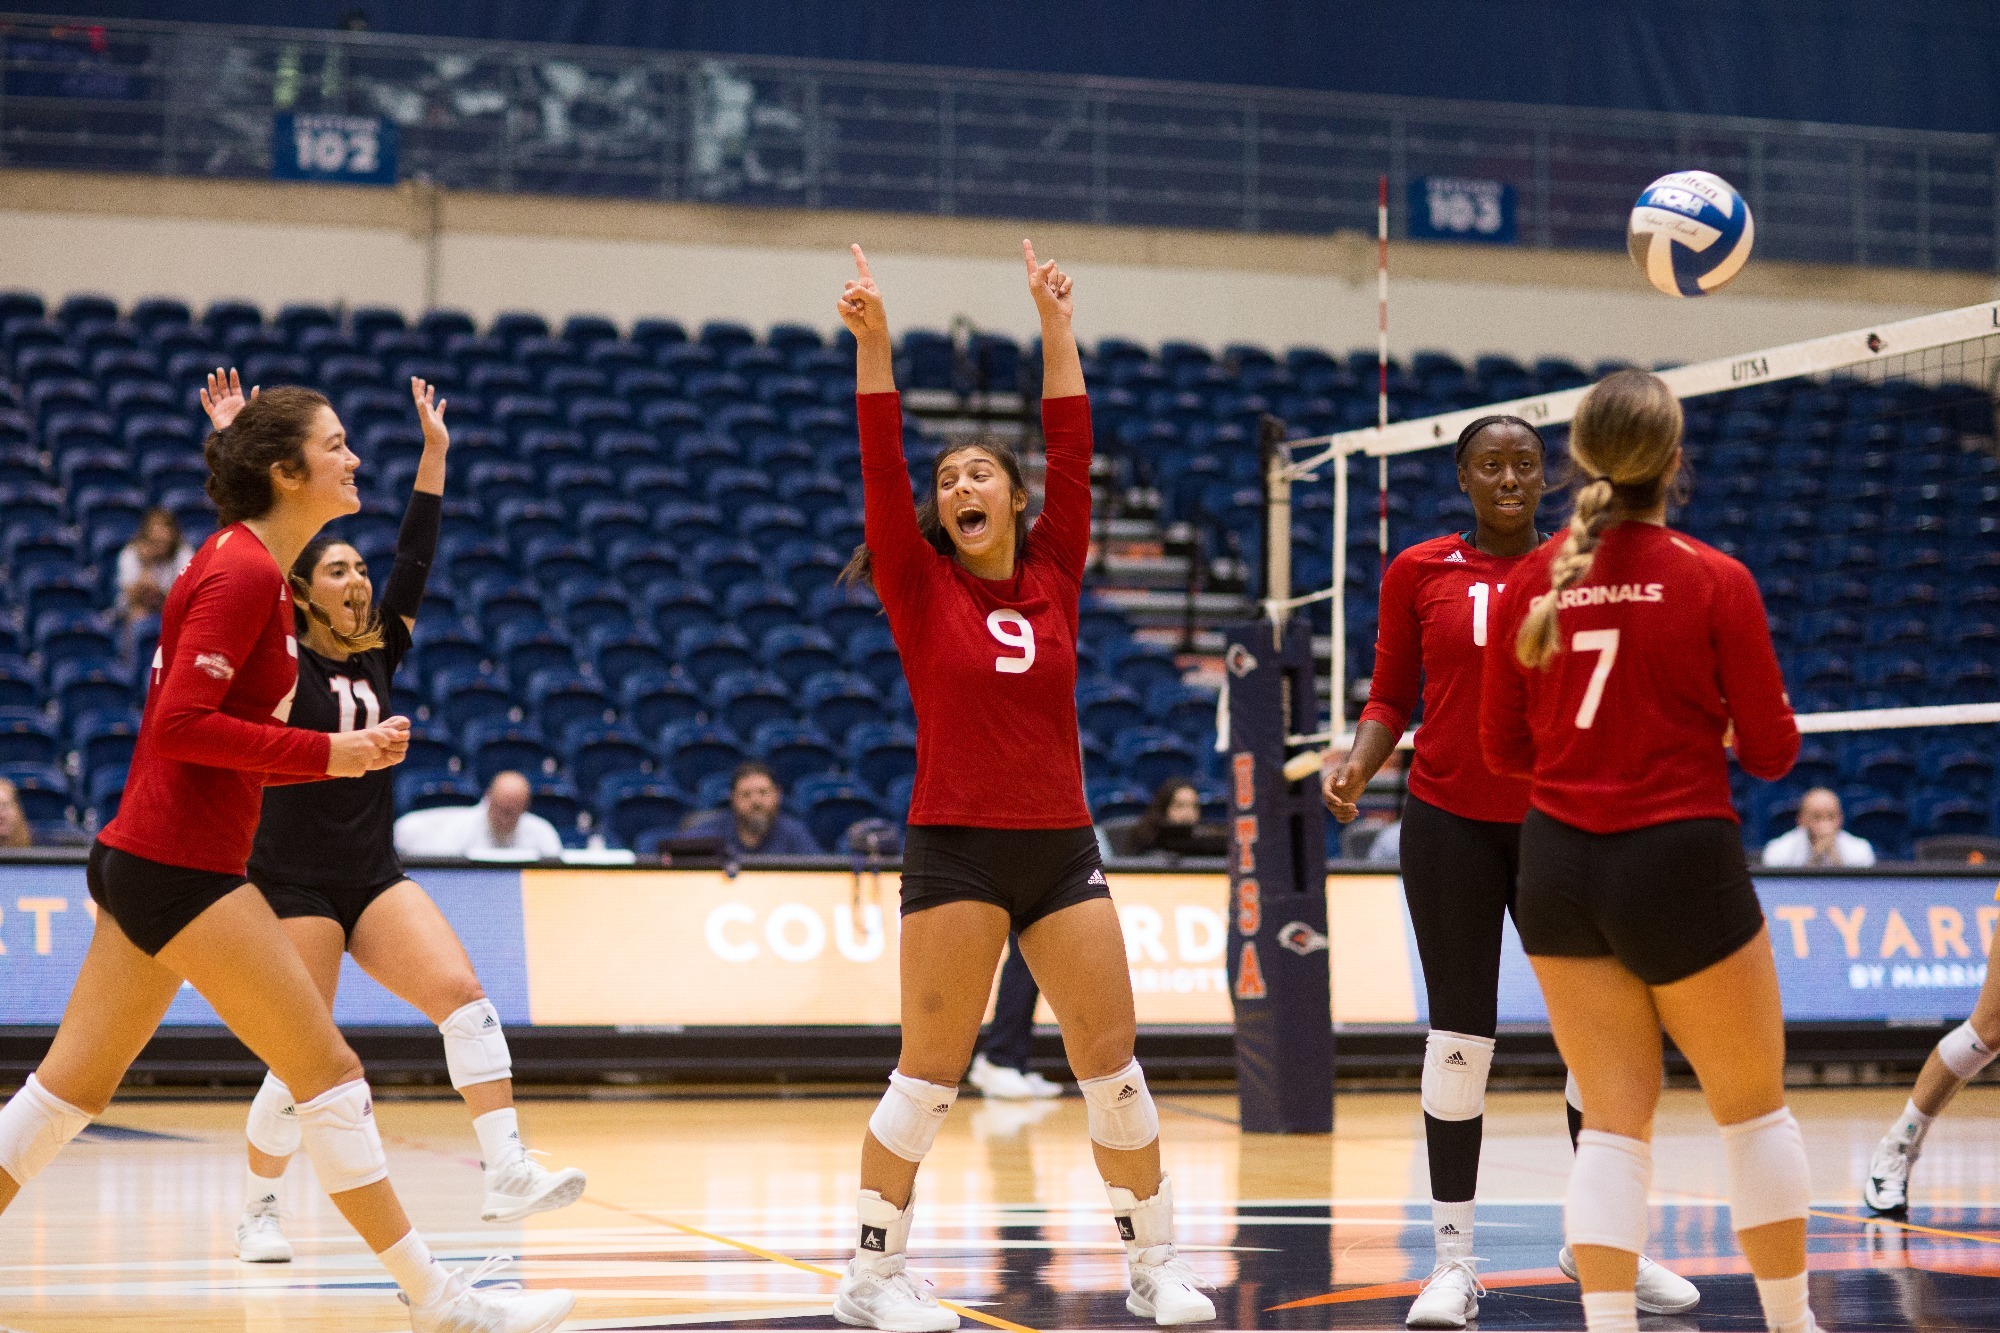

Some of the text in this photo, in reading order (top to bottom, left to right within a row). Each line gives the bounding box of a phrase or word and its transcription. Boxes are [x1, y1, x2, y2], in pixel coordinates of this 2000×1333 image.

[297, 133, 379, 172] 102
[1429, 193, 1501, 232] 103
[1648, 187, 1703, 217] NCAA
[1731, 356, 1769, 381] UTSA
[987, 608, 1036, 674] 9
[1572, 628, 1620, 729] 7
[329, 674, 380, 732] 11
[1233, 751, 1266, 999] UTSA
[1849, 963, 1884, 989] BY
